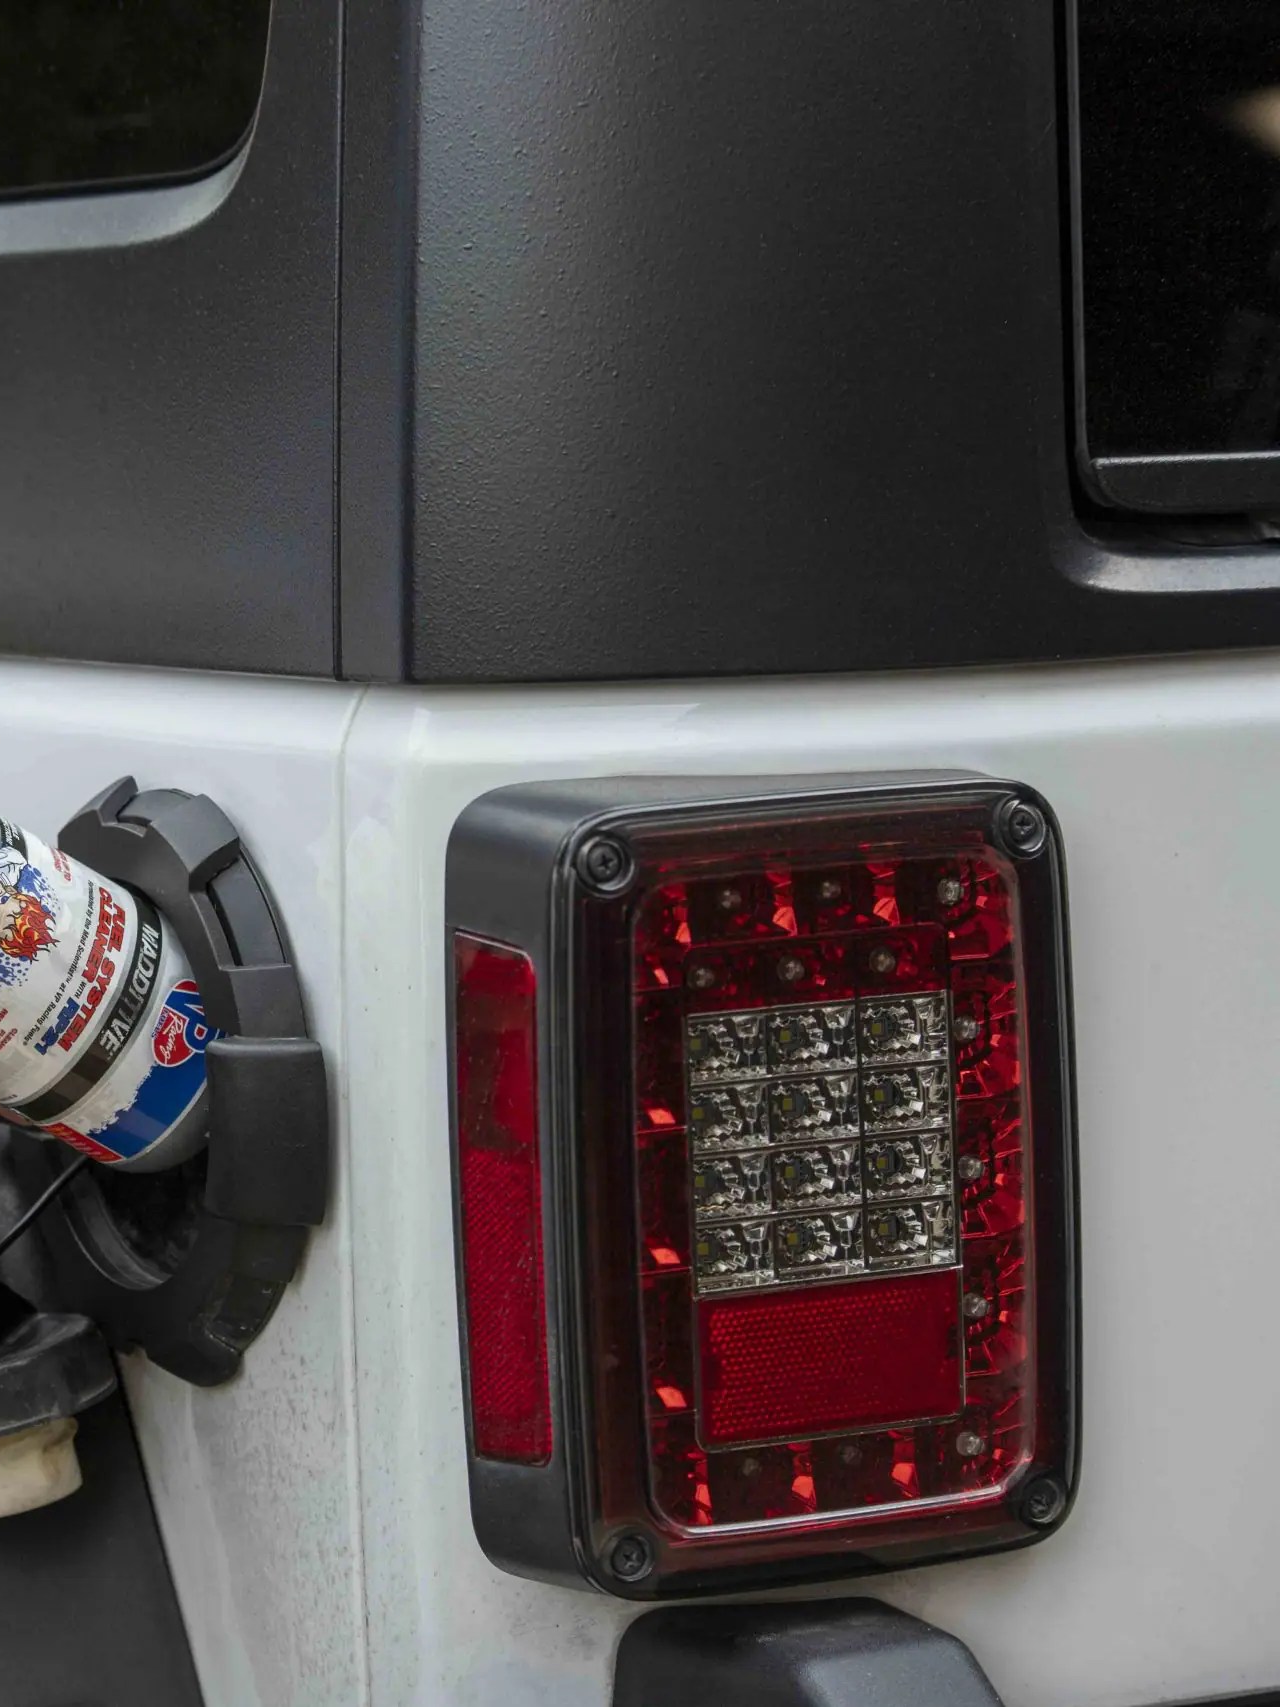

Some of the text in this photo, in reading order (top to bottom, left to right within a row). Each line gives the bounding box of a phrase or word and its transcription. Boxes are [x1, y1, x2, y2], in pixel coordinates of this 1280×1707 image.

[86, 909, 93, 919] by
[80, 929, 89, 944] Mad
[82, 887, 113, 982] CLEANER
[58, 903, 125, 1051] FUEL SYSTEM
[59, 981, 66, 992] at
[54, 992, 62, 1003] VP
[75, 981, 87, 998] WITH
[37, 1001, 55, 1024] Racing
[152, 1008, 169, 1039] FUELS
[160, 1012, 183, 1064] Racing
